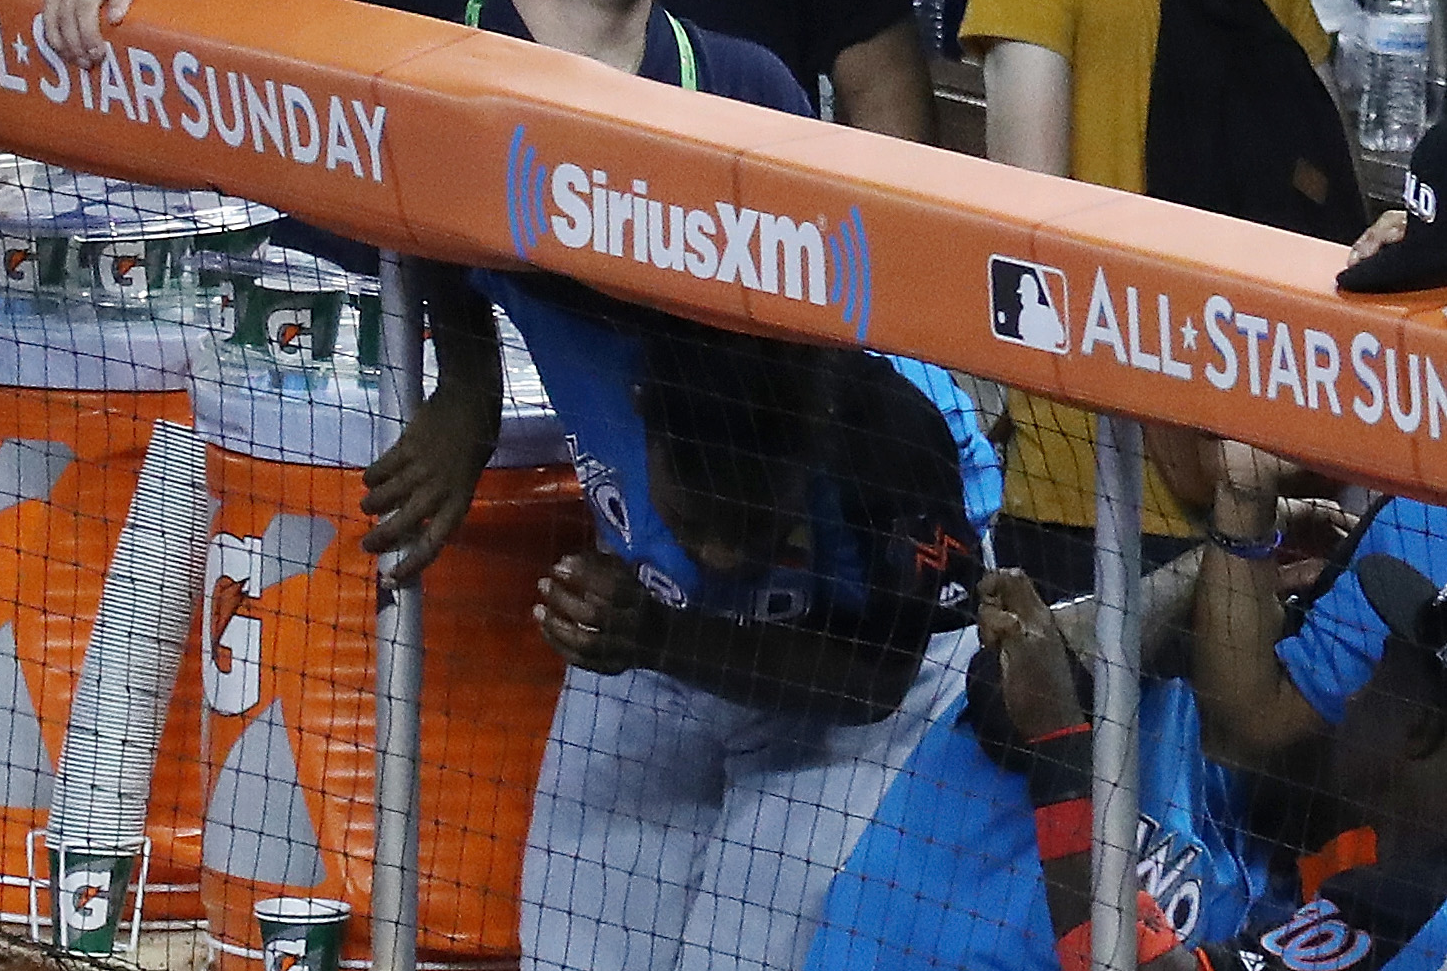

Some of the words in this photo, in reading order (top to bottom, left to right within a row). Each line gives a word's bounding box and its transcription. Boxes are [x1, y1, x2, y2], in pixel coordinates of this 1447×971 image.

[171, 50, 387, 184] SUNDAY
[1081, 265, 1193, 380] ALL
[1204, 293, 1343, 417] STAR
[204, 531, 262, 716] G
[61, 870, 111, 931] G
